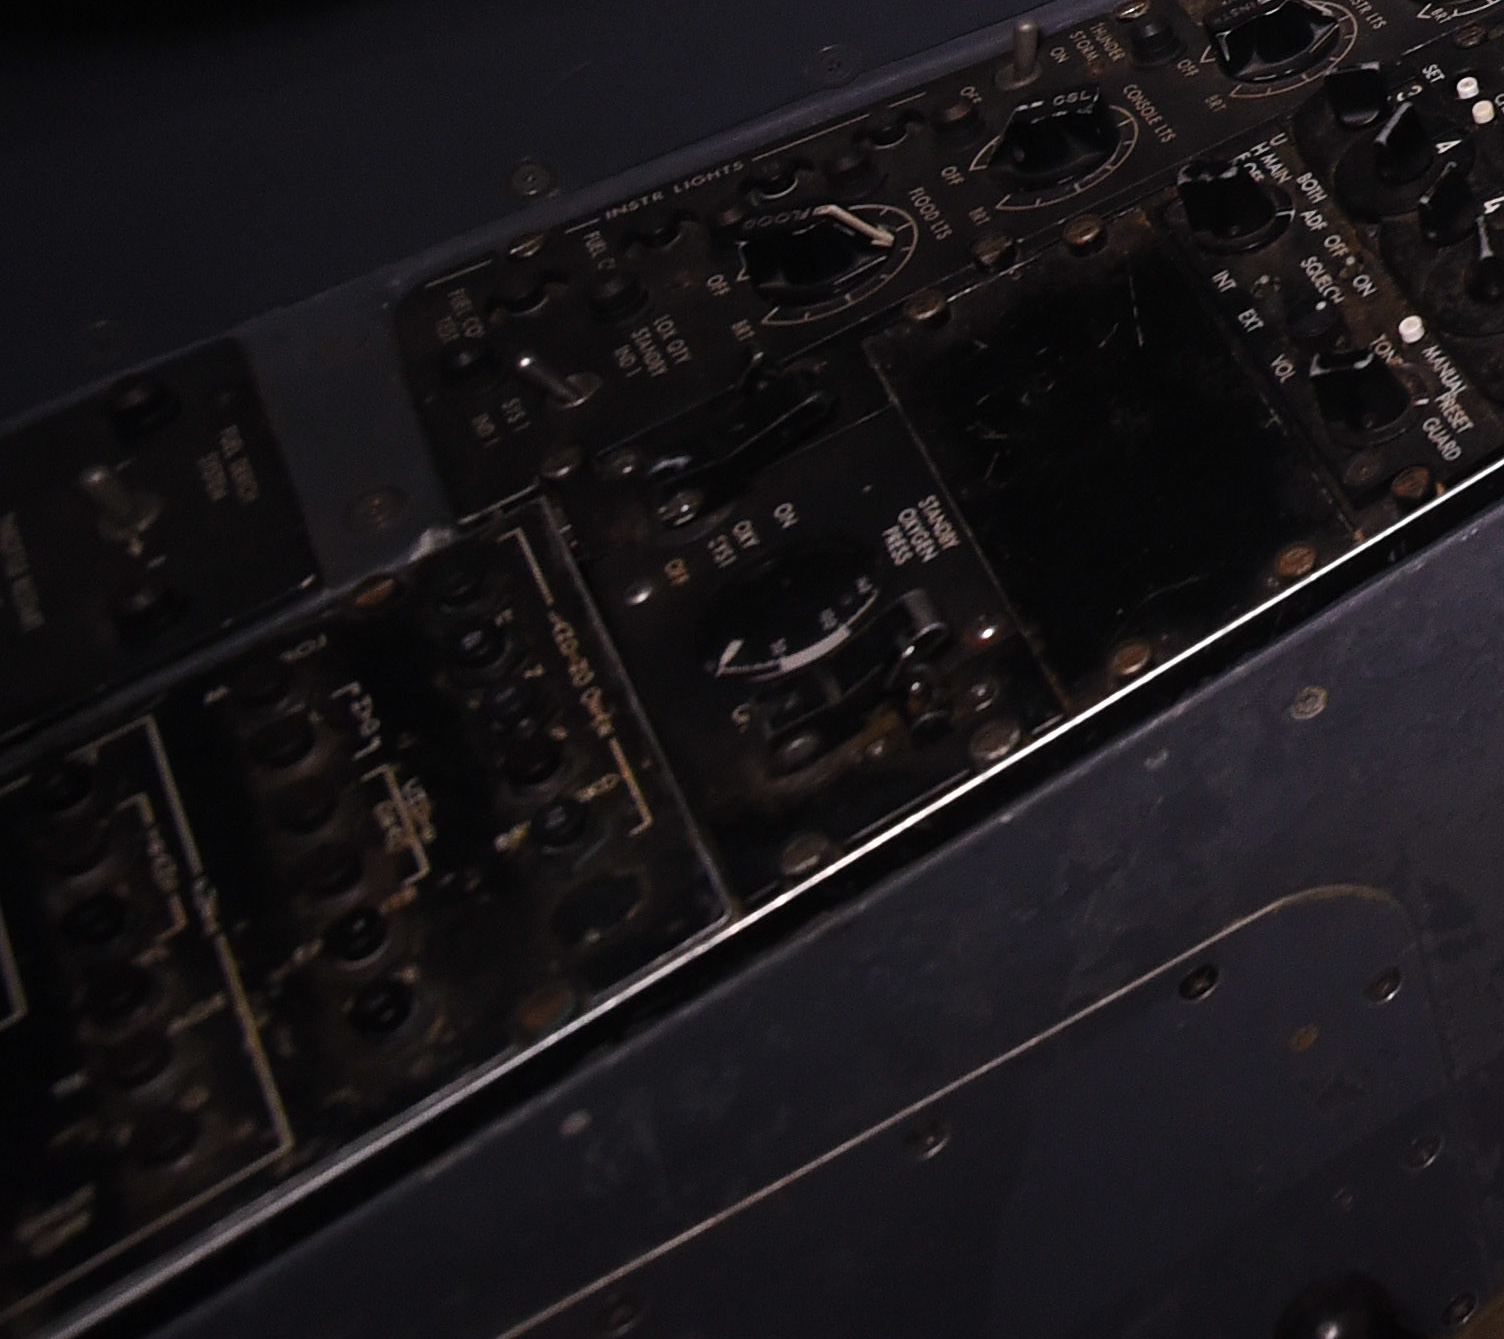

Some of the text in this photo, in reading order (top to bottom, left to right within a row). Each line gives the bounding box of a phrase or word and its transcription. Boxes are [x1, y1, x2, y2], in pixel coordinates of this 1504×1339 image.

[605, 162, 744, 219] INSTR LIGHTS
[1300, 255, 1345, 305] SQUELCH
[1422, 418, 1460, 461] GUARD
